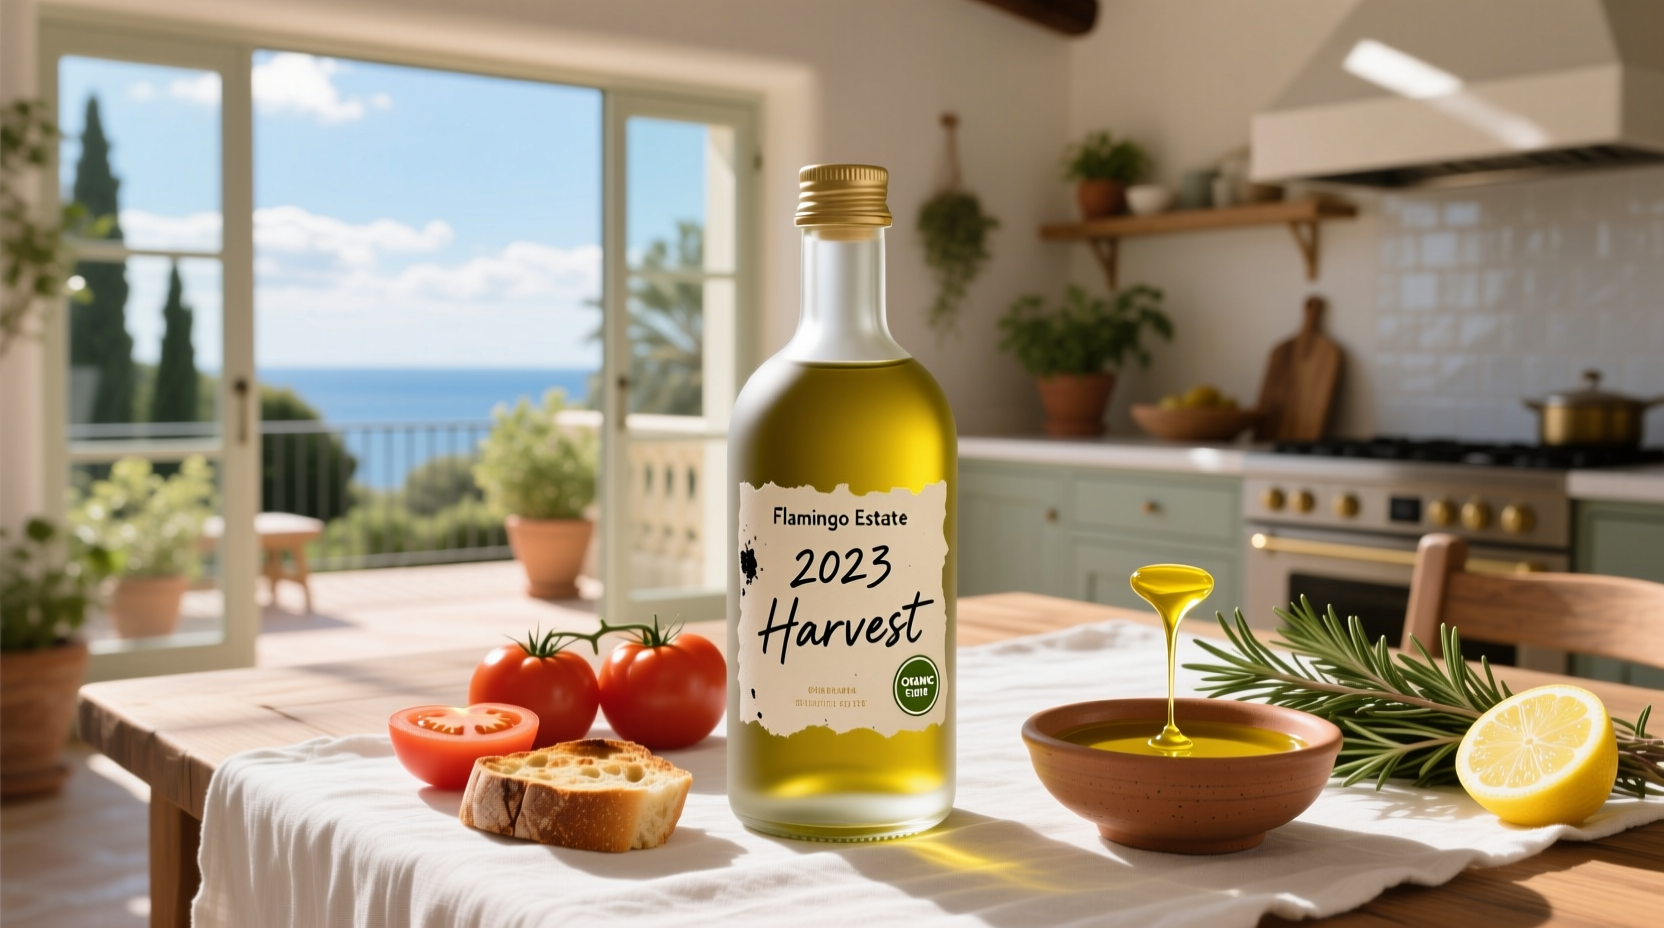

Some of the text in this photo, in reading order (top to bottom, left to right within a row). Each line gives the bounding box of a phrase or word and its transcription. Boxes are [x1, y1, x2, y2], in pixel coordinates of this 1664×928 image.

[773, 506, 908, 532] Flamingo Estate
[789, 544, 892, 589] 2023
[758, 590, 935, 665] Harvest
